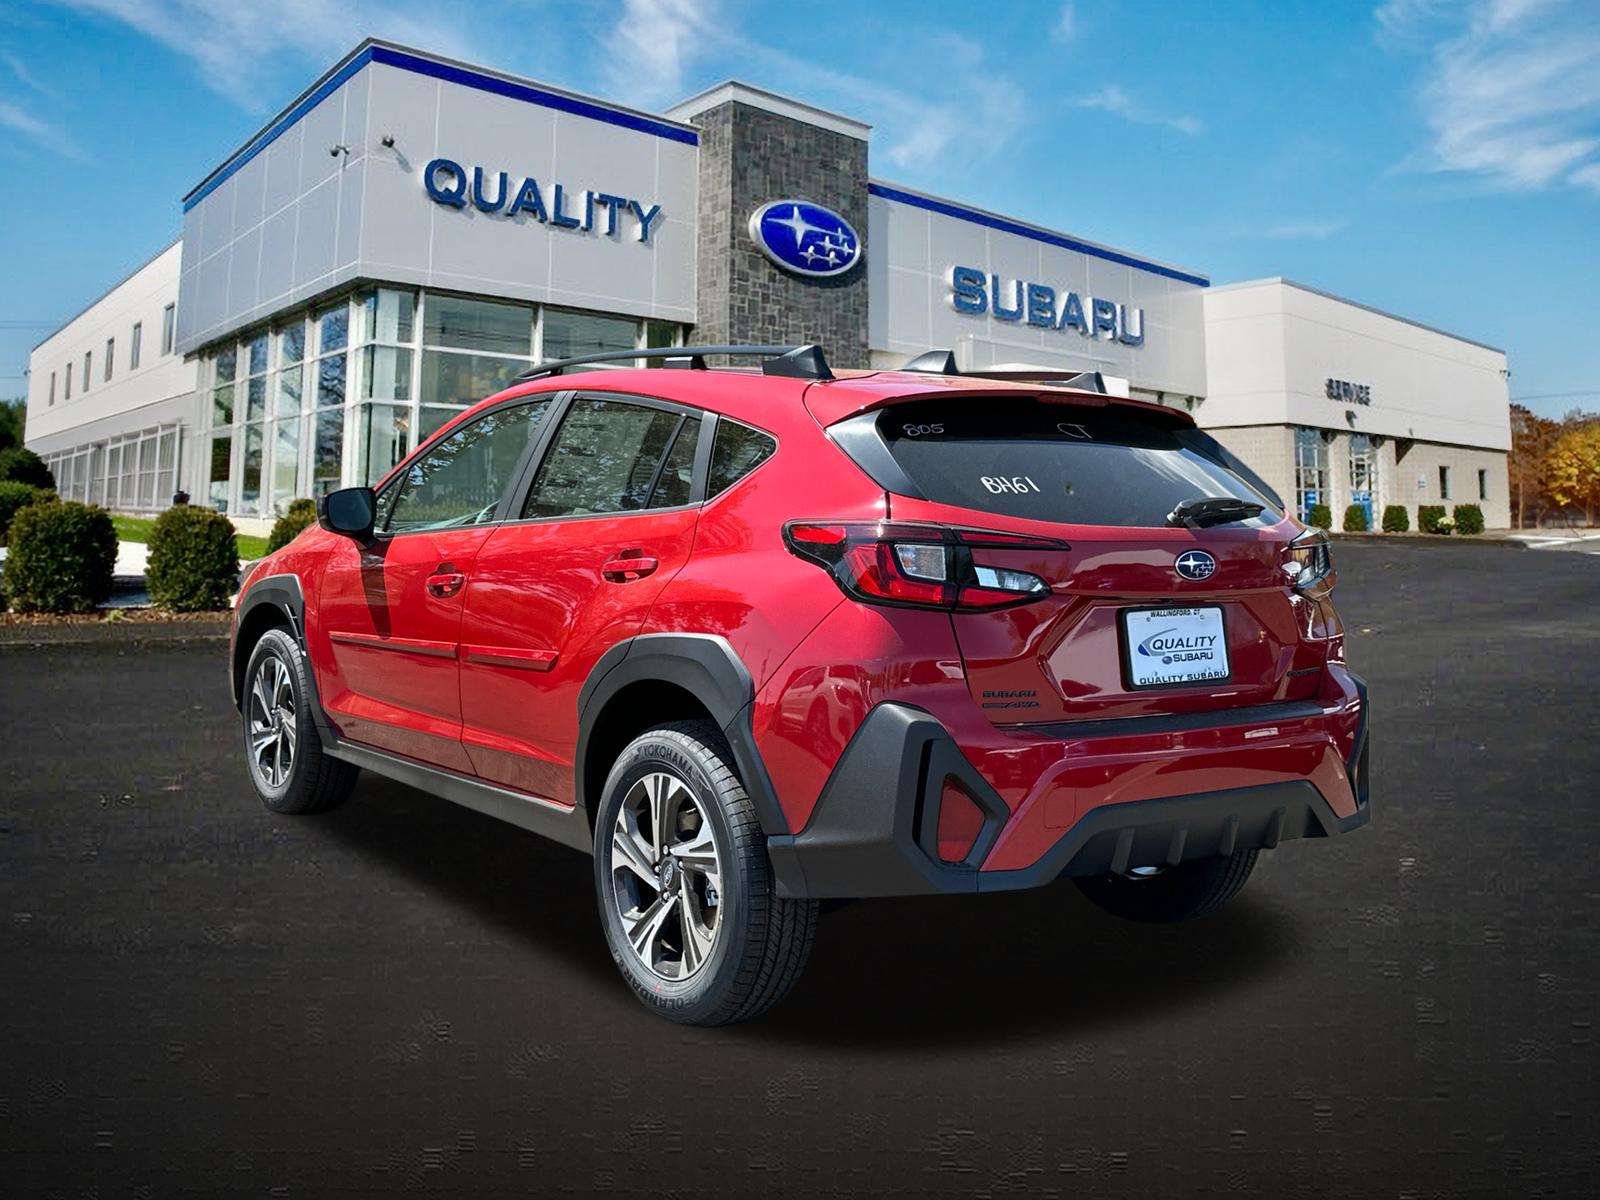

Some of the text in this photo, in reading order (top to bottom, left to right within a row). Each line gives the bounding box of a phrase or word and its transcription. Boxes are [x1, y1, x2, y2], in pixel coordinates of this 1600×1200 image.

[423, 157, 662, 243] QUALITY
[951, 264, 1146, 347] SUBARU
[1325, 378, 1371, 406] SERVICE
[902, 423, 945, 437] 805
[980, 475, 1041, 495] BH61
[1151, 635, 1217, 651] QUALITY
[1172, 651, 1214, 663] SUBARU
[1139, 670, 1227, 685] QUALITY SUBARU
[982, 690, 1037, 698] SUBARU
[643, 743, 694, 778] YOKOHAMA
